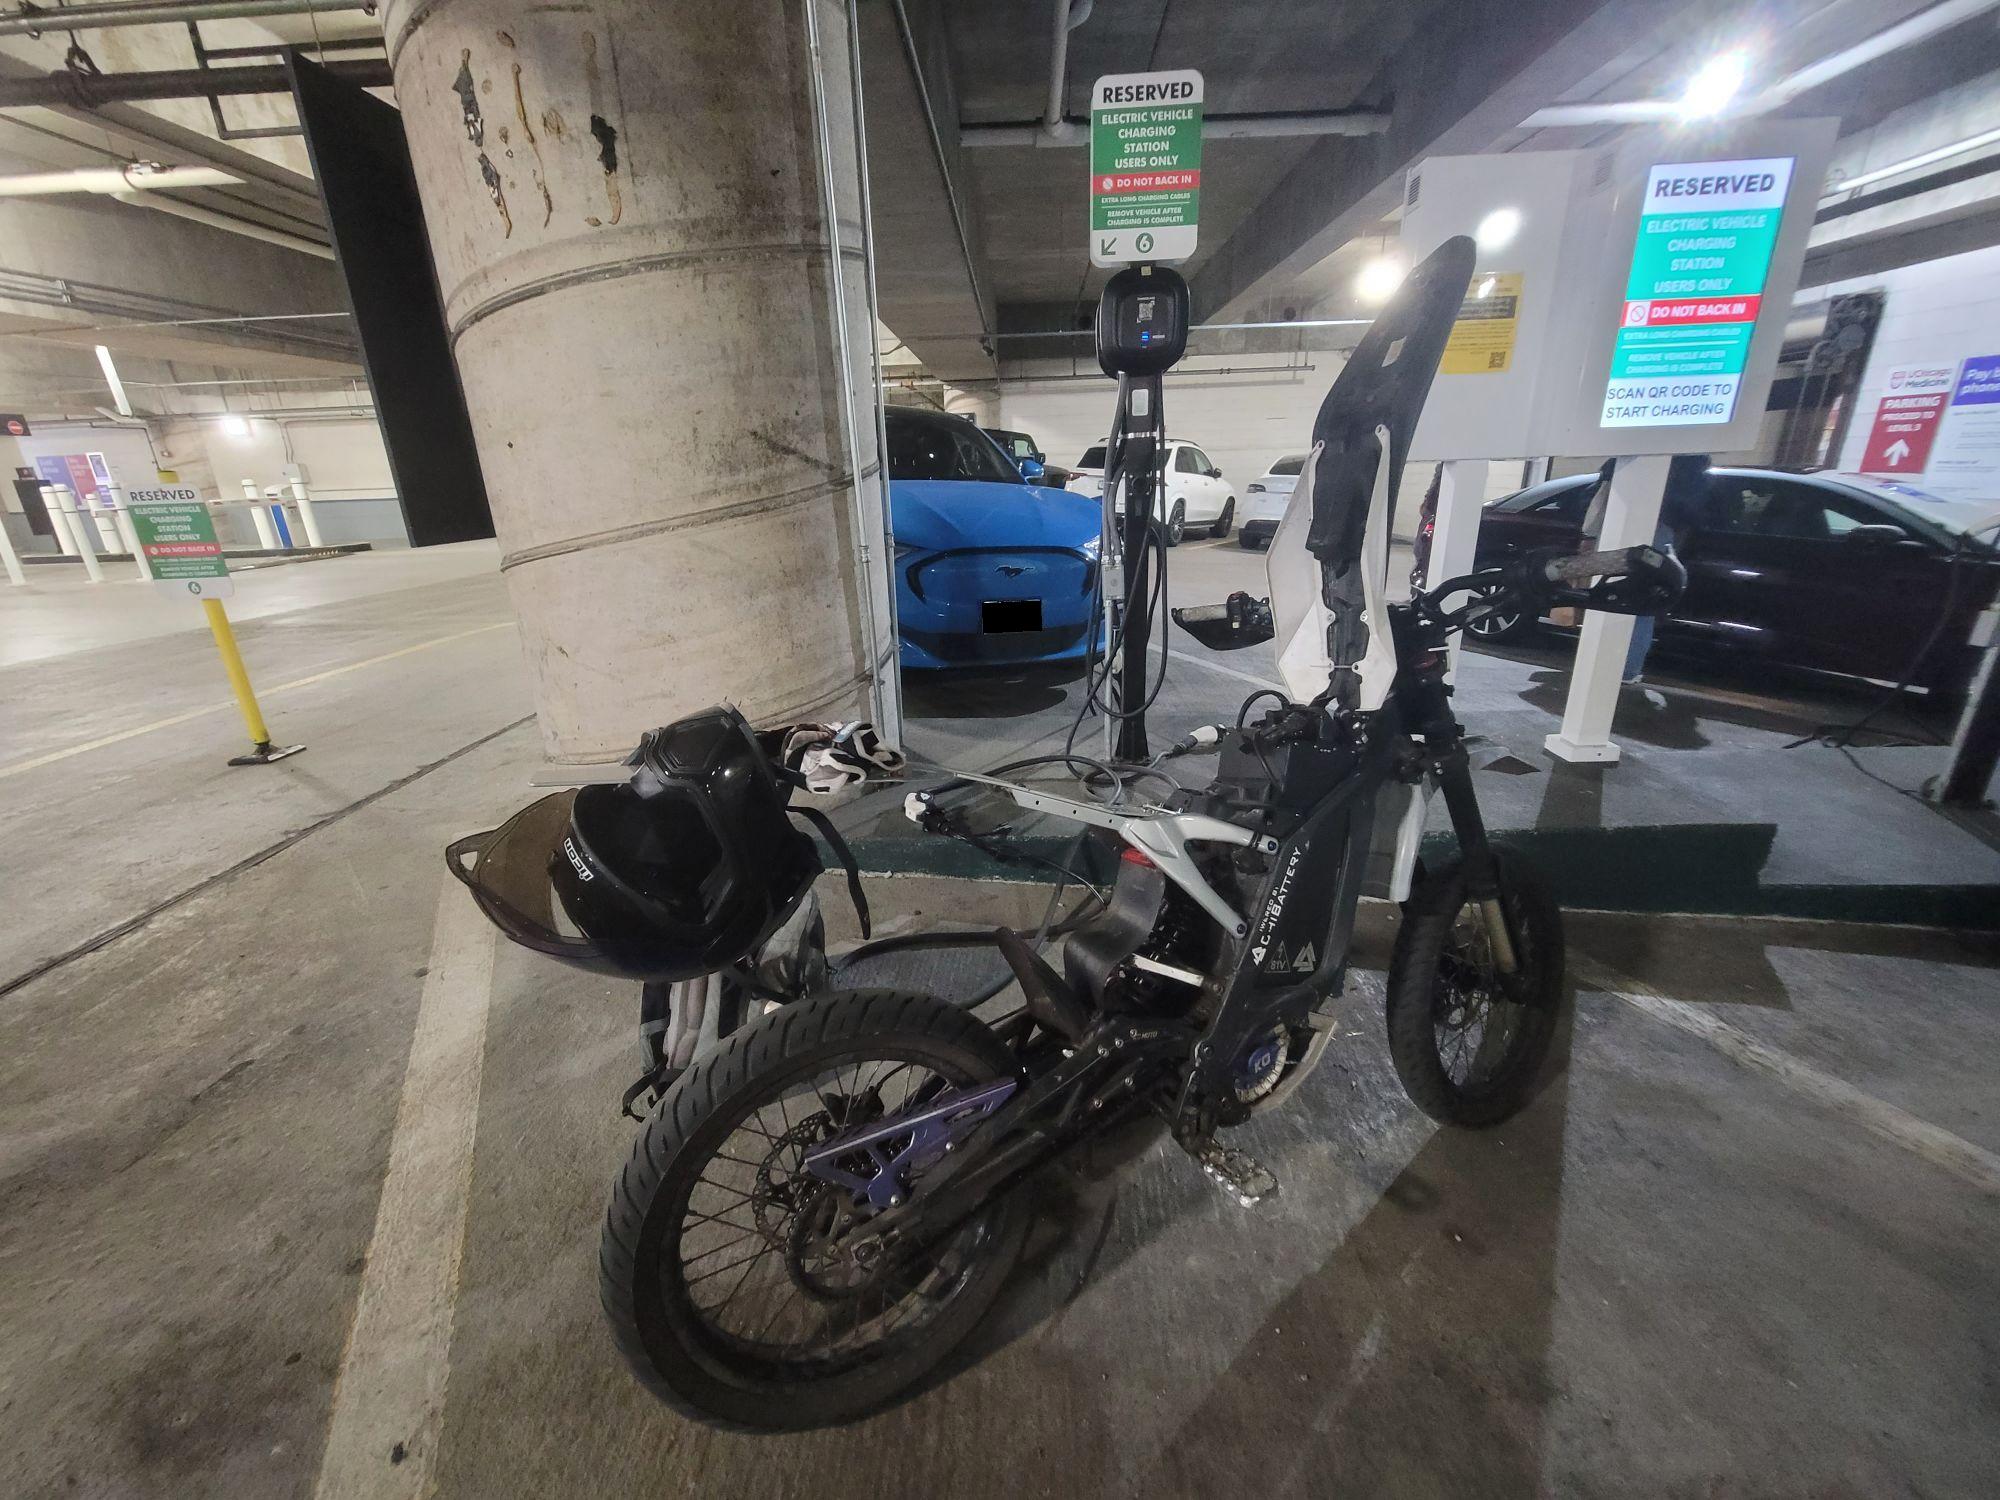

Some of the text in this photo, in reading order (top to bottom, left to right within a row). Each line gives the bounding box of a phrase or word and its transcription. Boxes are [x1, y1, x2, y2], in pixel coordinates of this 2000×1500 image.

[1103, 82, 1194, 103] RESERVED
[1102, 109, 1194, 125] ELECTRIC VEHICLE
[1118, 125, 1176, 138] CHARGING
[1124, 141, 1170, 153] STATION
[1115, 155, 1179, 168] USERS ONLY
[1117, 175, 1192, 188] DO NOT BACK IN
[1654, 174, 1776, 198] RESERVED
[1135, 208, 1161, 216] VEHICLE
[1151, 216, 1184, 224] COMPLETE
[1646, 215, 1768, 233] ELECTRIC VEHICLE
[1139, 235, 1151, 252] 6
[1668, 236, 1736, 252] CHARGING
[1670, 257, 1724, 271] STATION
[1654, 278, 1733, 293] USERS ONLY
[1651, 302, 1746, 318] DO NOT BACK IN
[1607, 383, 1732, 400] SCAN QR CODE TO
[1606, 403, 1724, 418] START CHARGING
[130, 489, 195, 502] RESERVED
